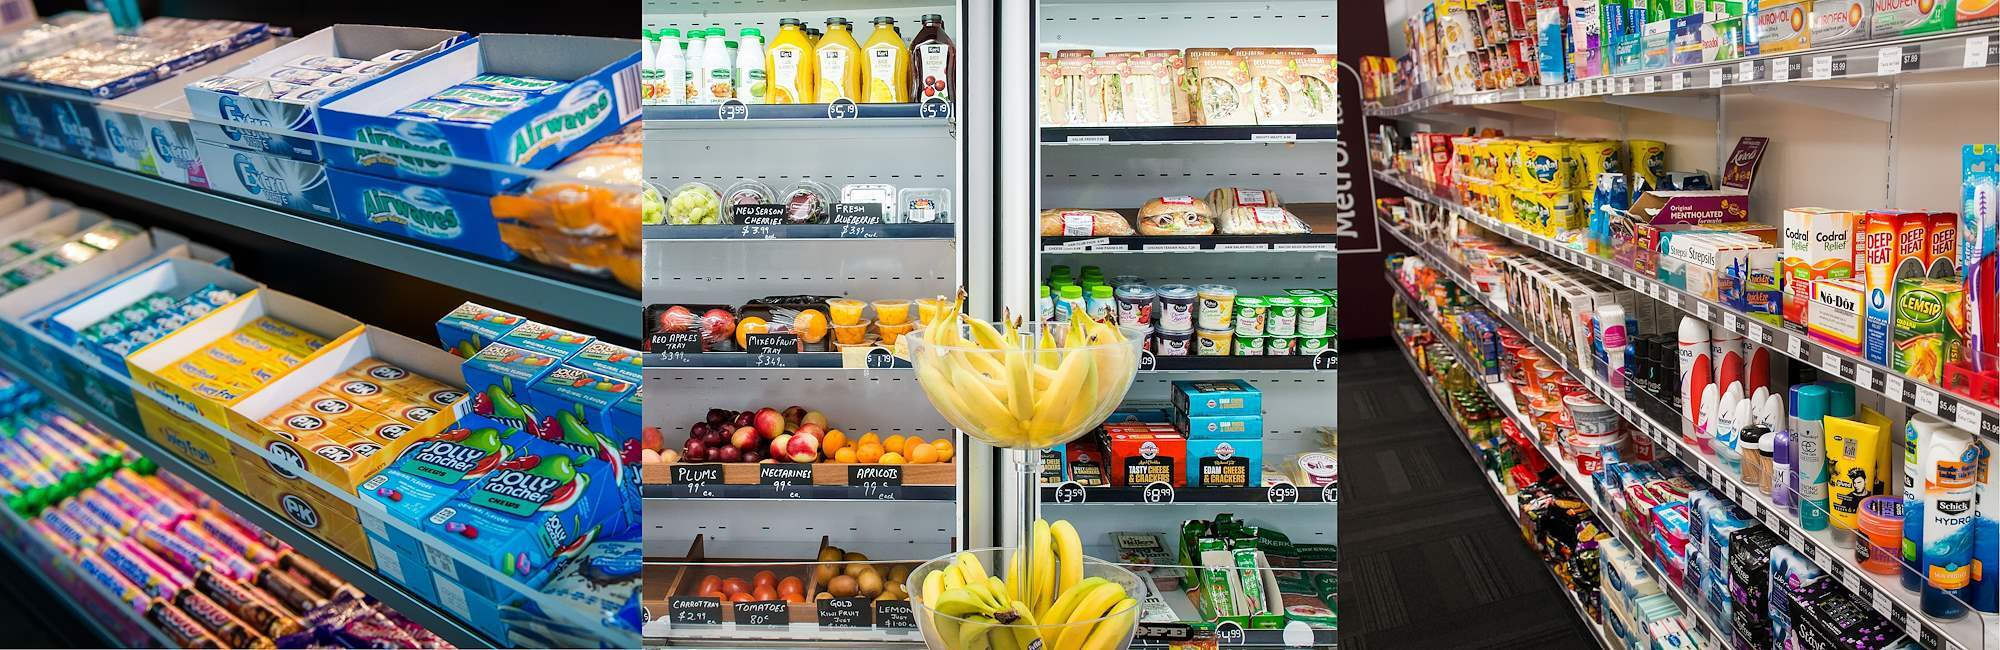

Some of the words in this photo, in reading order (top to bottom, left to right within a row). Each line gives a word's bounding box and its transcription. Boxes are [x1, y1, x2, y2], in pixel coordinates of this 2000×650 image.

[515, 90, 609, 159] Airwaves
[354, 126, 452, 166] Airwaves
[364, 188, 459, 229] Airwaves
[736, 207, 754, 216] NEW
[755, 207, 784, 216] SEASON
[836, 204, 865, 214] FRESH
[1670, 204, 1693, 213] Original
[744, 216, 782, 226] CHERRIES
[834, 215, 880, 225] BLUEBERRIES
[1670, 211, 1723, 220] MENTHOLATED
[1786, 227, 1809, 242] Codral
[1816, 230, 1847, 242] Codral
[1867, 232, 1893, 249] DEEP
[1900, 228, 1924, 245] DEEP
[1932, 228, 1955, 245] DEEP
[1824, 241, 1847, 252] Relief
[1900, 239, 1924, 255] HEAT
[1932, 239, 1954, 255] HEAT
[1689, 247, 1715, 266] Strepsils
[1867, 248, 1892, 264] HEAT
[1901, 295, 1942, 316] LEMSIP
[669, 334, 698, 343] APPLES
[1939, 401, 1956, 413] $5.49
[427, 441, 486, 463] JOLLY
[417, 451, 474, 473] rancher
[417, 465, 447, 477] CHEWS
[678, 467, 717, 483] PLUMS
[760, 468, 812, 480] NECTARINES
[856, 468, 898, 480] APRICOTS
[1129, 465, 1148, 475] TASTY
[1148, 465, 1170, 475] CHEESE
[1203, 465, 1222, 475] EDAM
[1223, 465, 1246, 475] CHEESE
[494, 469, 560, 494] JOLLY
[1129, 474, 1135, 483] &
[1135, 474, 1170, 483] CRACKERS
[1203, 474, 1210, 483] &
[1210, 474, 1246, 483] CRACKERS
[485, 482, 548, 504] rancher
[488, 497, 521, 510] CHEWS
[1939, 501, 1969, 511] Schick
[735, 603, 786, 613] TOMATOES
[830, 600, 853, 608] GOLD
